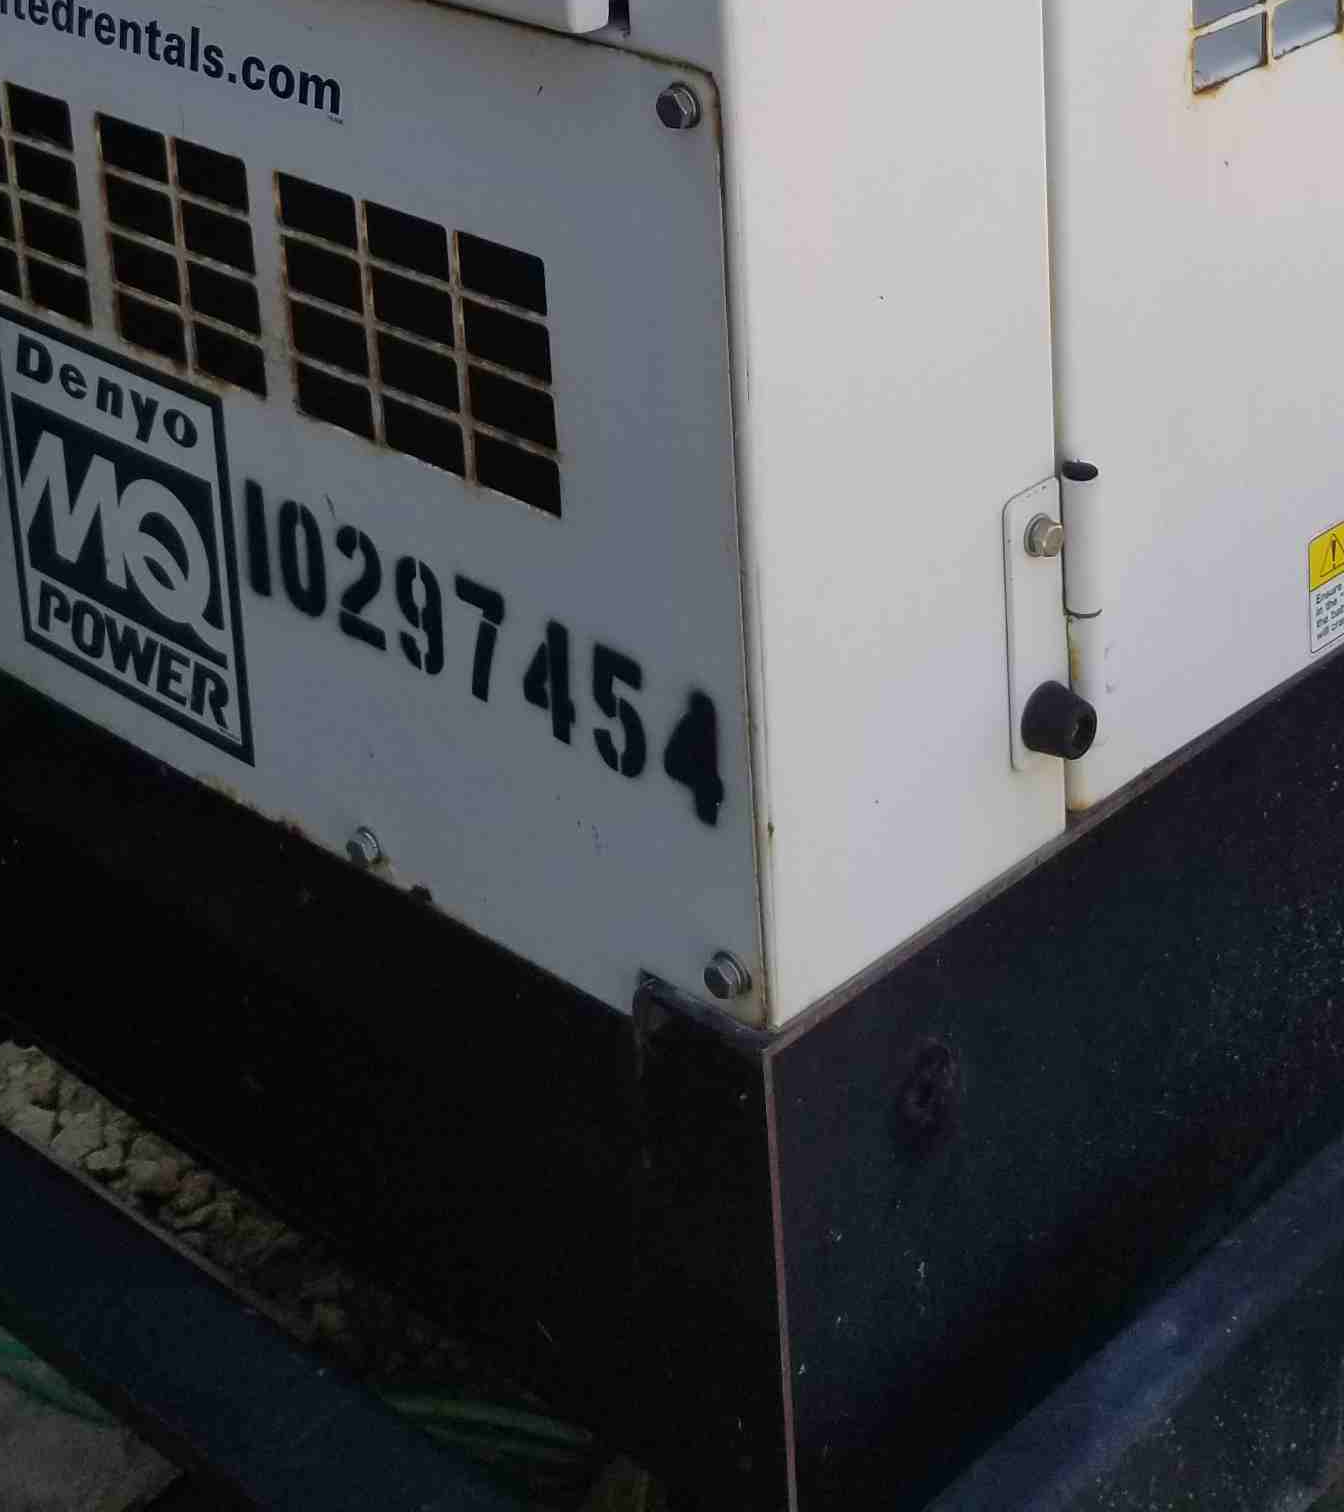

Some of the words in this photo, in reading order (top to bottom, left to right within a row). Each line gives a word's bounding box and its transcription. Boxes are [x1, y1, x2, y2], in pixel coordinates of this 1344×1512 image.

[15, 333, 198, 448] Denyo
[21, 430, 228, 654] MQ
[1315, 581, 1342, 605] Ensure
[38, 579, 229, 730] POWER
[244, 477, 725, 828] 10297454
